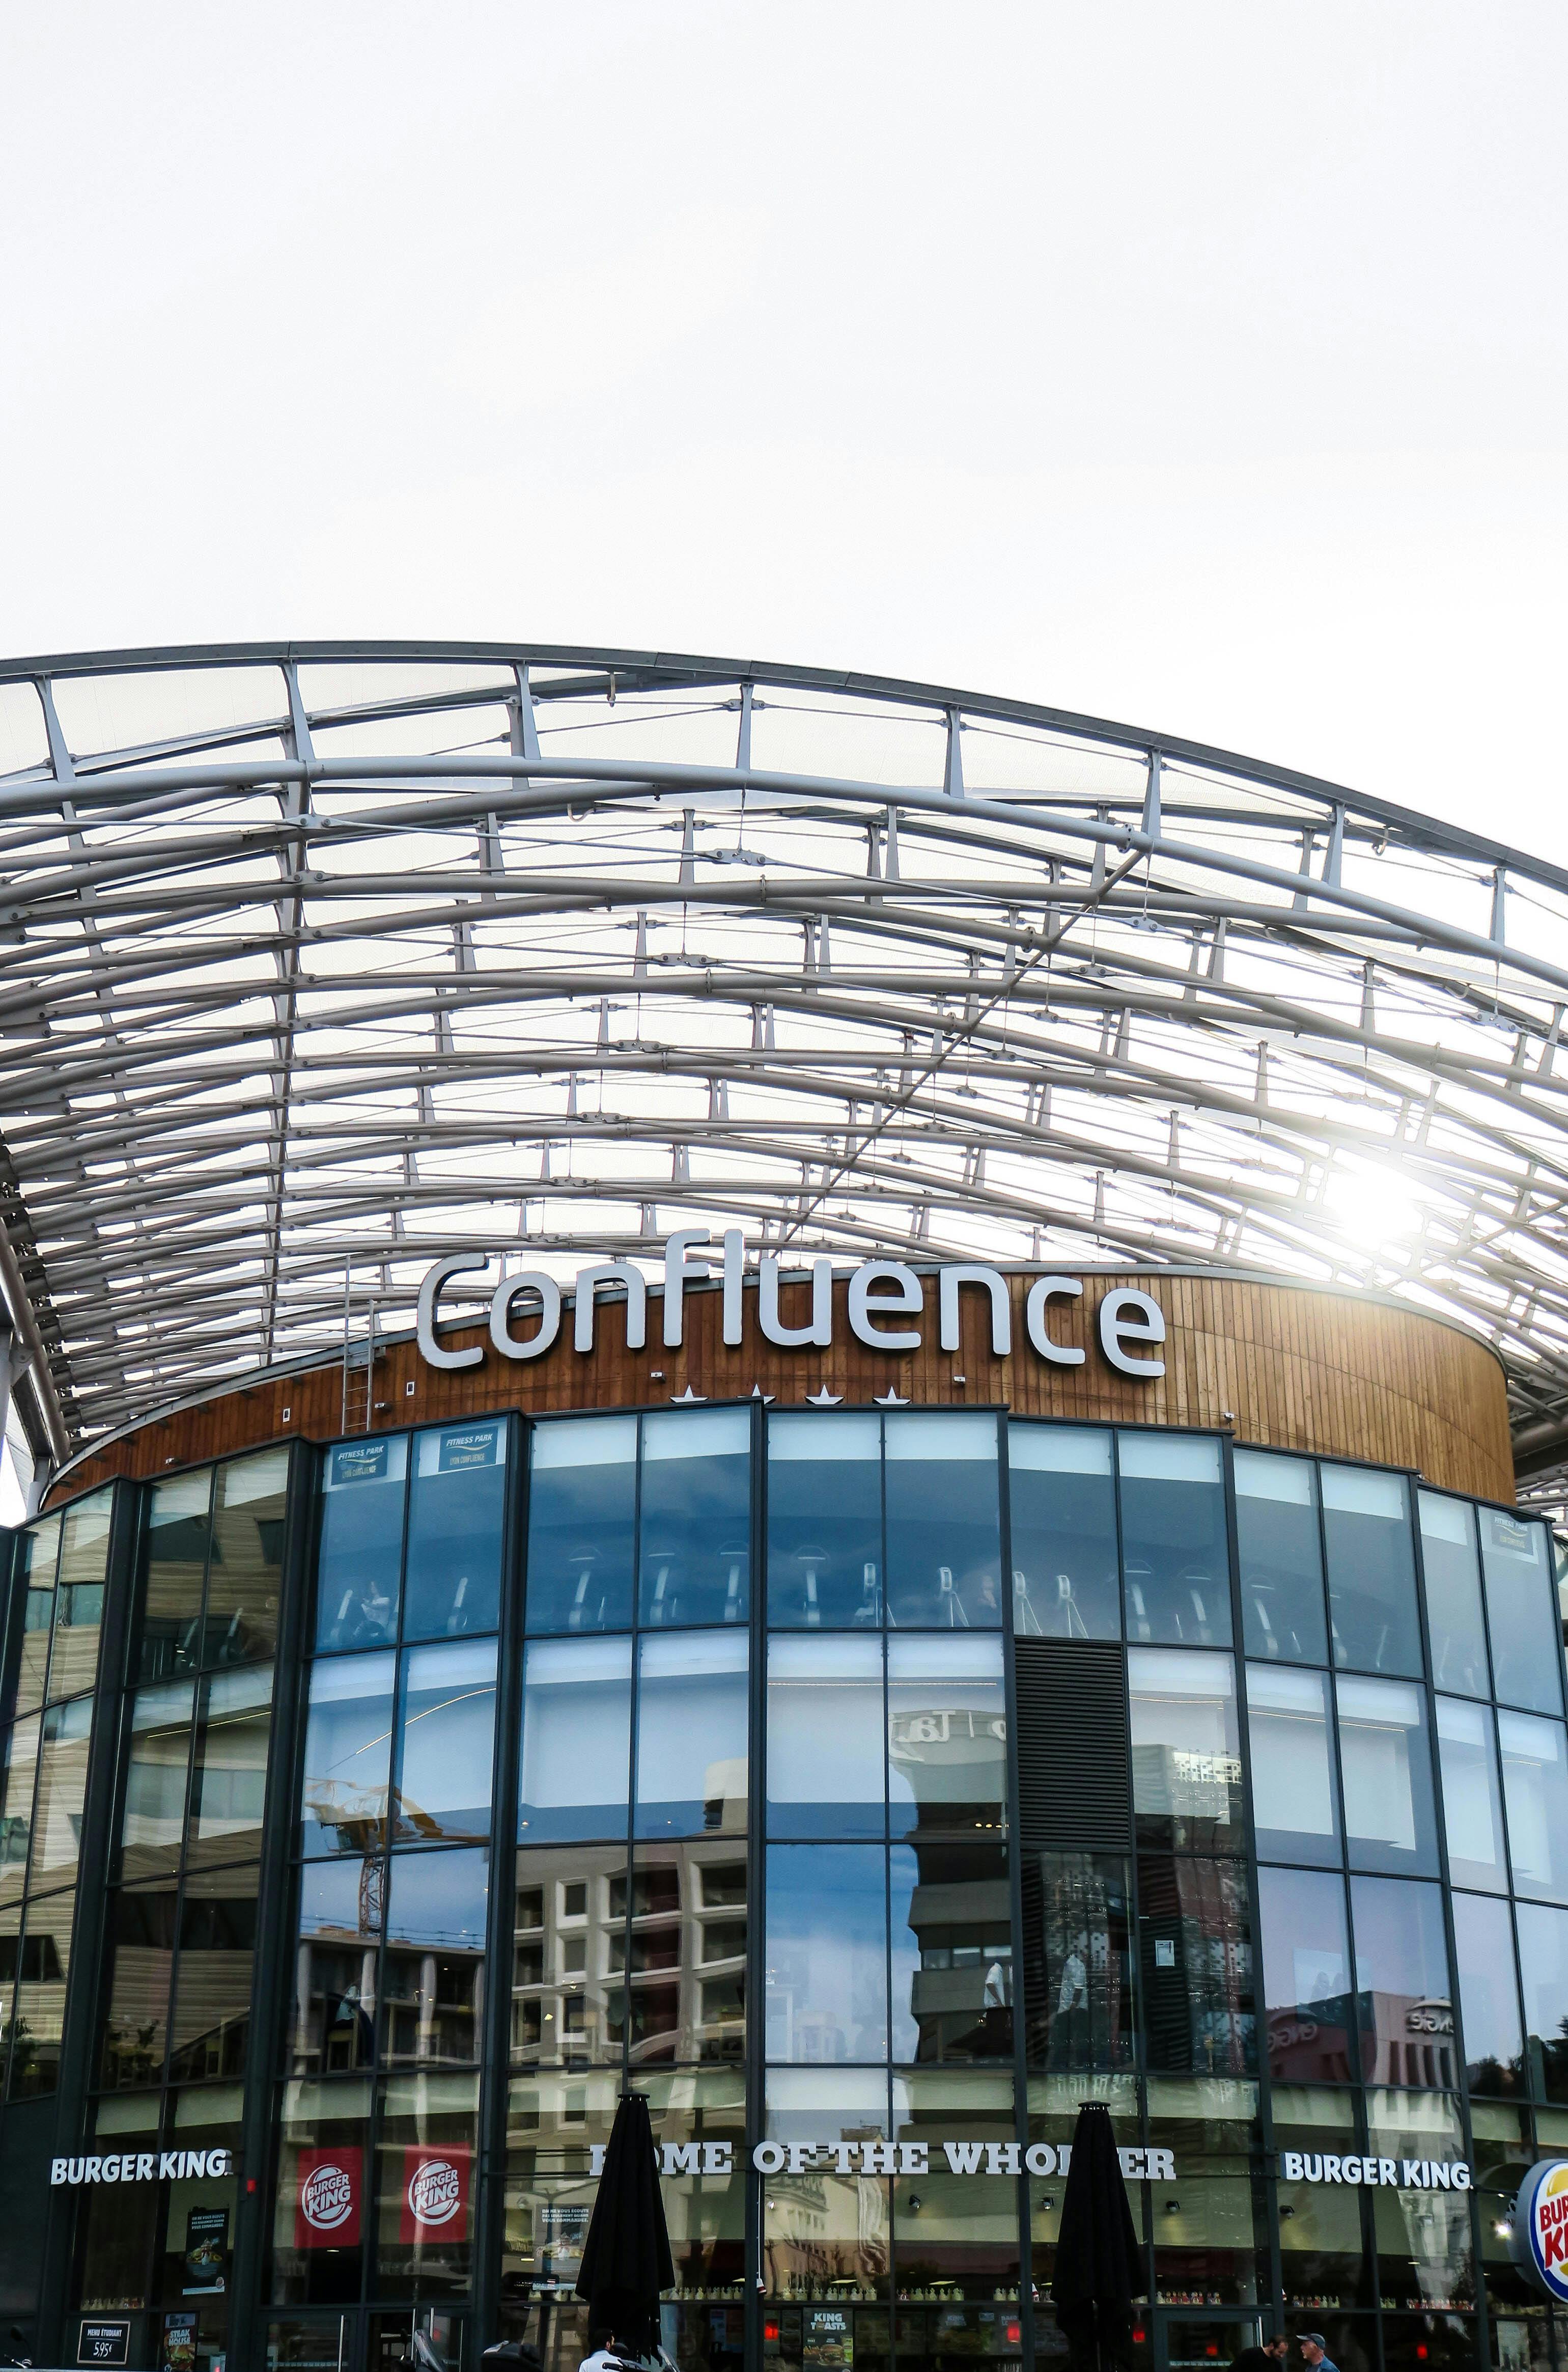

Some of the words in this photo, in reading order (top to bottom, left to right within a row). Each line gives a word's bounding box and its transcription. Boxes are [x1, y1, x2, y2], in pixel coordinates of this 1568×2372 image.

[416, 1229, 1166, 1376] Confluence
[445, 1437, 473, 1446] FITNESS
[474, 1433, 493, 1442] PARK
[338, 1449, 365, 1460] FITNESS
[366, 1446, 384, 1454] PARK
[460, 1453, 485, 1464] CONFLUENCE
[51, 2154, 153, 2185] BURGER
[159, 2149, 227, 2180] KING
[590, 2142, 732, 2176] ME
[753, 2141, 816, 2173] OF
[828, 2142, 928, 2174] THE
[943, 2142, 1177, 2180] WHOER
[1285, 2152, 1397, 2186] BURGER
[1403, 2159, 1471, 2190] KING
[307, 2174, 349, 2200] BURGER
[414, 2169, 458, 2196] BURGER
[308, 2186, 350, 2216] KING
[415, 2181, 459, 2214] KING
[810, 2322, 847, 2330] TASTS
[814, 2313, 843, 2322] KING
[101, 2328, 122, 2337] ÉTUDIANT
[169, 2337, 190, 2346] HOUSE
[170, 2329, 190, 2338] STEAK
